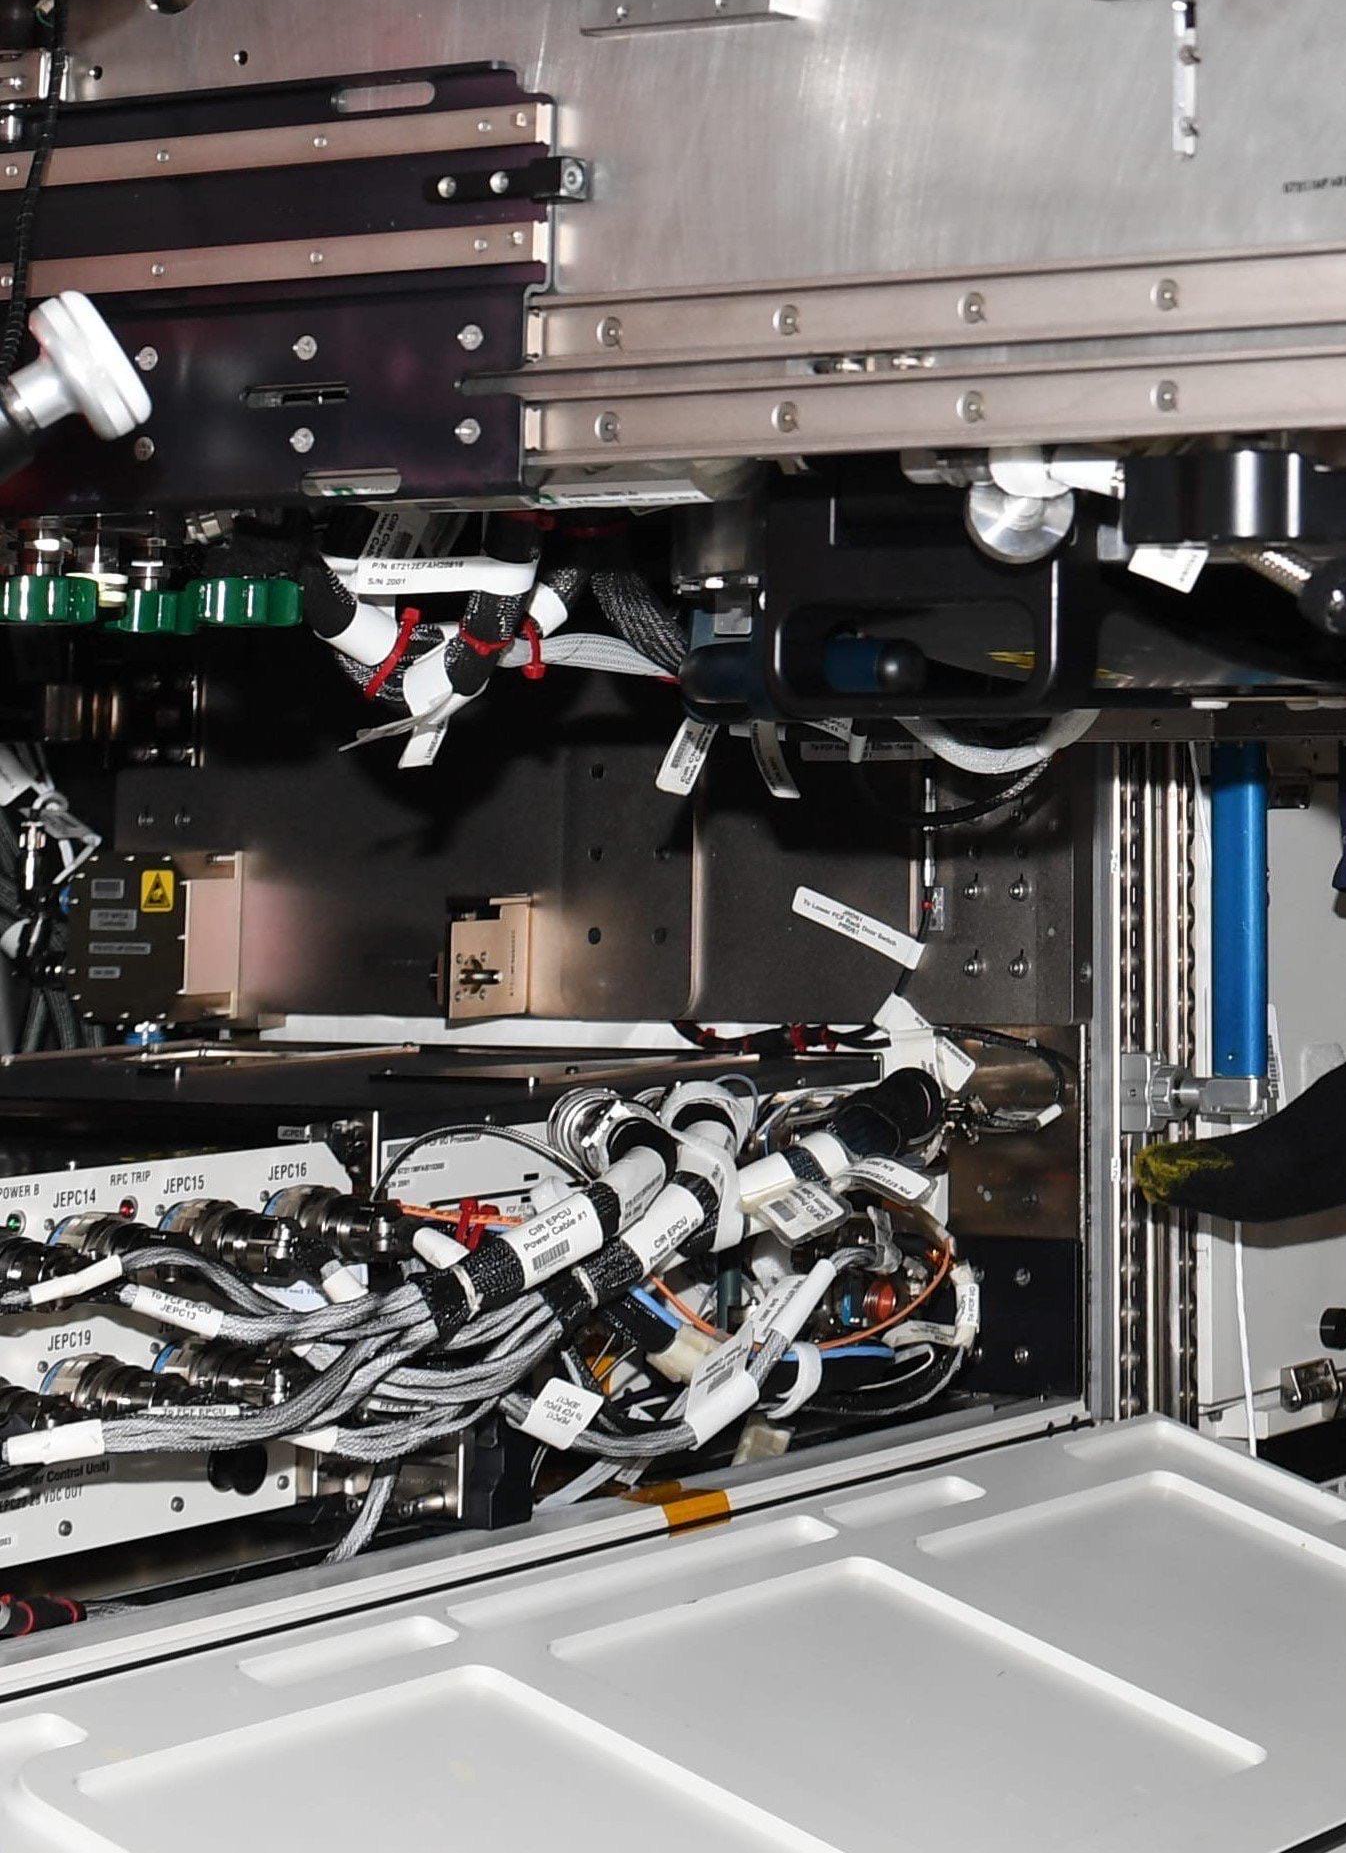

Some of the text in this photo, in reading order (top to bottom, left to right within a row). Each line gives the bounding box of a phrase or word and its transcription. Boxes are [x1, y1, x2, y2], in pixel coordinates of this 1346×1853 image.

[372, 562, 388, 570] P/N
[386, 577, 406, 586] 2001
[812, 903, 830, 916] Lower
[845, 917, 861, 929] Rack
[862, 925, 877, 937] Door
[878, 932, 897, 947] Switch
[110, 1170, 151, 1186] RPC TRIP
[268, 1162, 307, 1181] JEPC16
[0, 1183, 40, 1198] POWER B
[163, 1175, 205, 1194] JEPC15
[53, 1188, 96, 1208] JEPC14
[523, 1211, 587, 1252] Power Cable #1
[528, 1208, 572, 1237] CIR EPCU
[653, 1216, 688, 1248] CIR EPCU
[150, 1290, 212, 1315] To FCF EPCU
[160, 1303, 197, 1321] JEPC13
[48, 1330, 92, 1350] JEPC19
[198, 1407, 226, 1415] EPCU
[543, 1399, 562, 1412] EPCU
[45, 1461, 110, 1481] Control Unit)
[42, 1484, 83, 1503] VDC OUT
